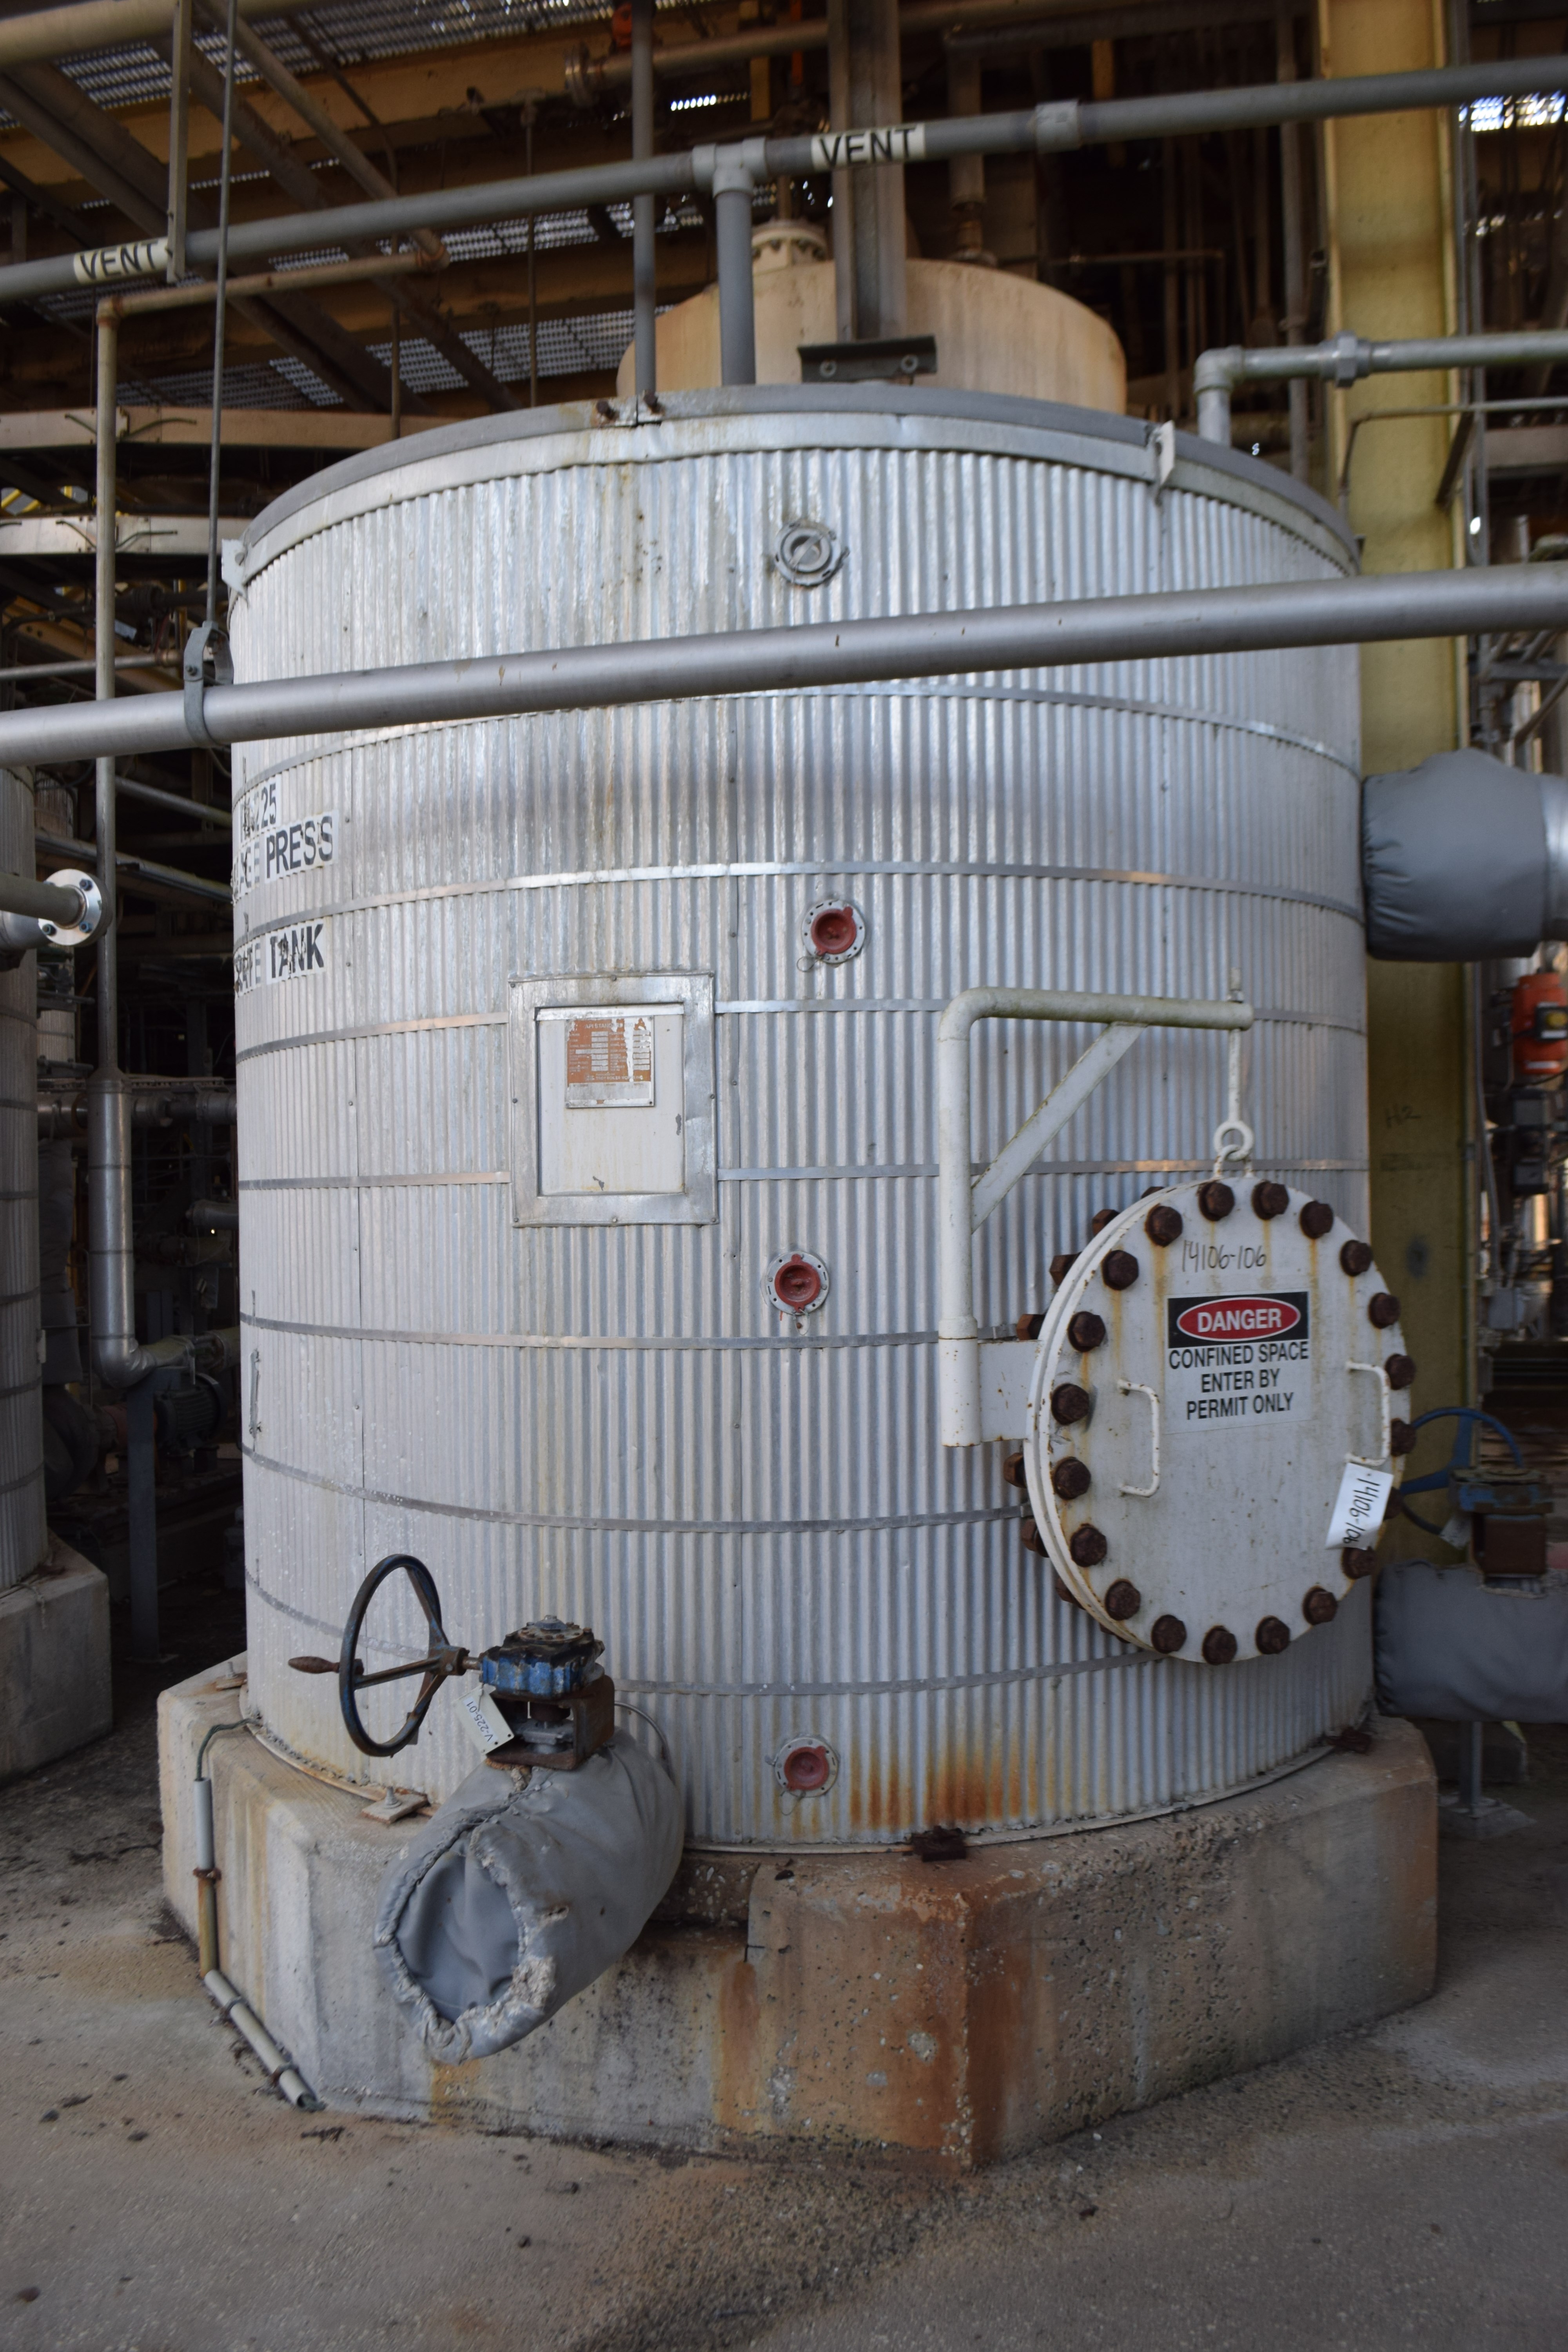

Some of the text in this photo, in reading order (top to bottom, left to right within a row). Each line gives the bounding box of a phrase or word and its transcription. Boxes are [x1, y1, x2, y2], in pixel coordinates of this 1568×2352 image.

[820, 126, 916, 165] VENT
[80, 240, 158, 279] VENT
[266, 816, 333, 878] PRESS
[270, 923, 324, 979] TANK
[1182, 1240, 1267, 1272] 14106-106
[1198, 1308, 1282, 1332] DANGER
[1169, 1341, 1309, 1370] CONFINED SPACE
[1201, 1368, 1280, 1393] ENTER BY
[1187, 1392, 1294, 1420] PERMIT ONLY
[1342, 1478, 1381, 1544] 14106-106
[466, 1701, 493, 1742] V-225-01
